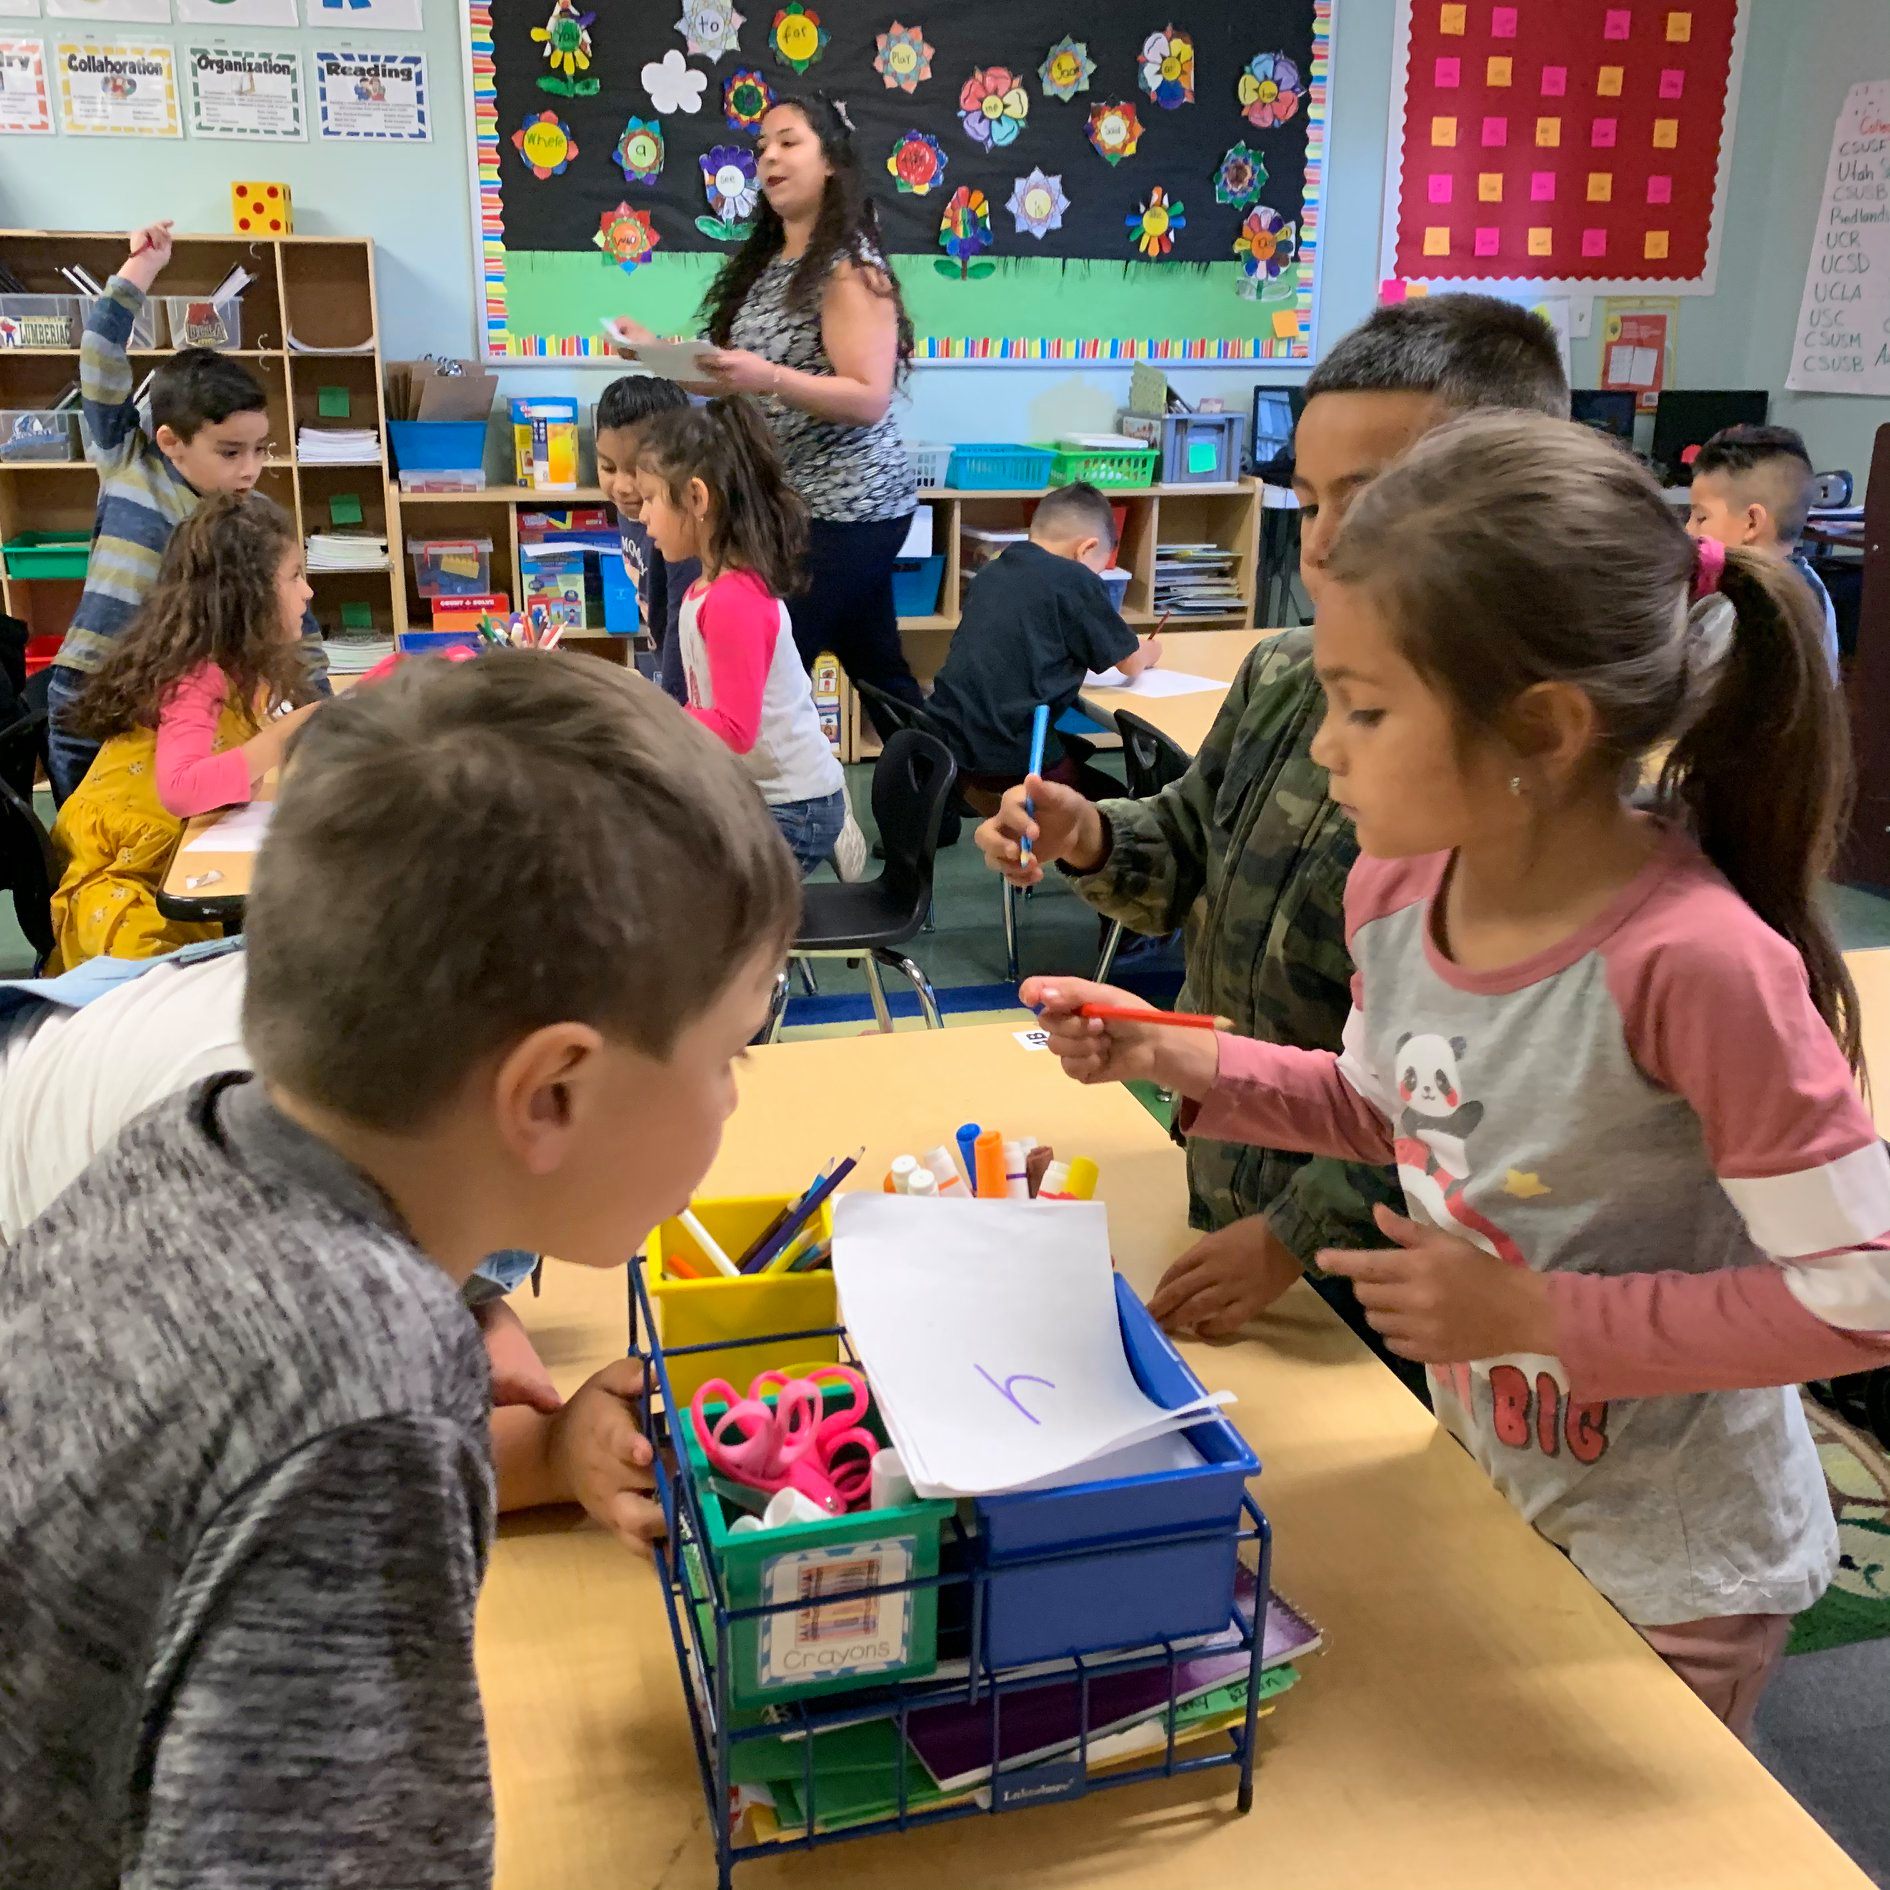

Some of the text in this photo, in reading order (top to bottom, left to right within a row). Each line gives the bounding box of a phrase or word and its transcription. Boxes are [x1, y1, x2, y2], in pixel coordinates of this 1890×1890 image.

[700, 15, 720, 33] to
[67, 53, 163, 76] Collaboration
[197, 54, 291, 75] Organization
[326, 61, 413, 81] Reading
[635, 144, 646, 157] a
[1838, 159, 1875, 182] Utah
[1826, 231, 1861, 250] UCR
[1821, 252, 1870, 274] UCSD
[1814, 281, 1862, 303] UCLA
[1810, 308, 1845, 328] USC
[1804, 331, 1862, 349] CSUSM
[1488, 1364, 1608, 1466] BIG
[783, 1641, 891, 1670] Crayons
